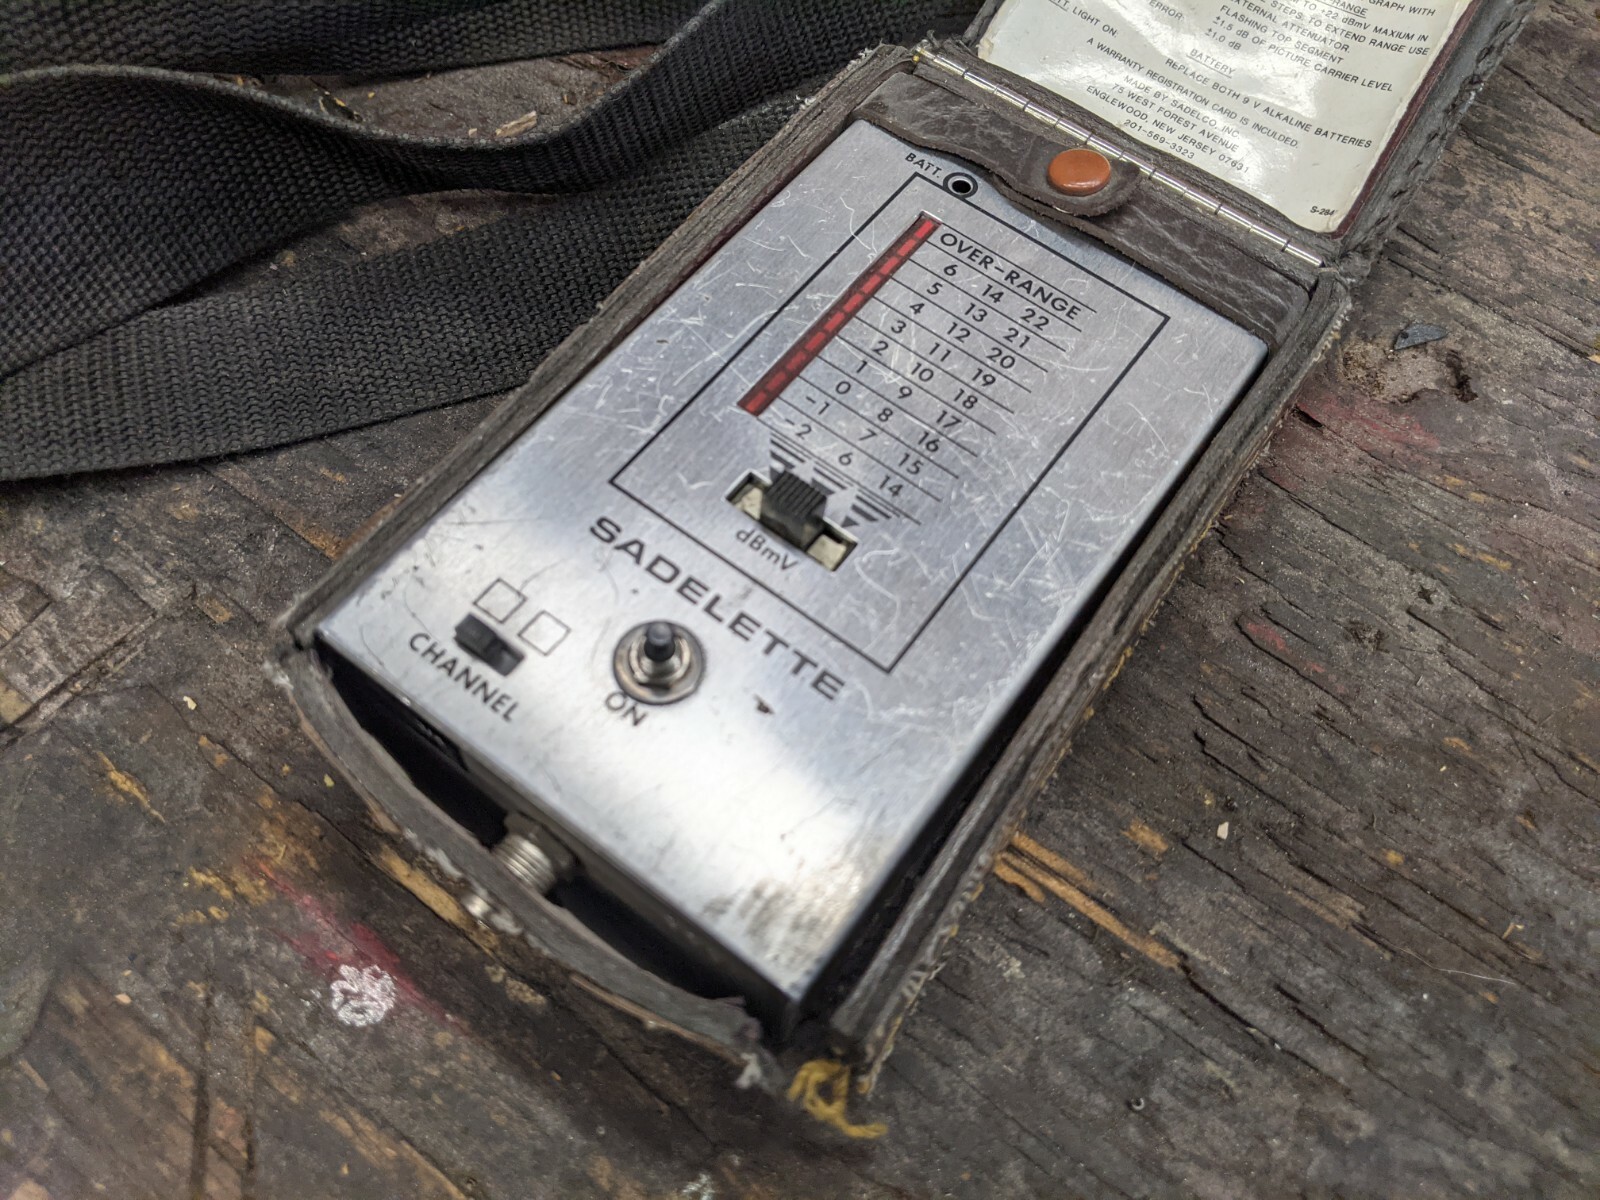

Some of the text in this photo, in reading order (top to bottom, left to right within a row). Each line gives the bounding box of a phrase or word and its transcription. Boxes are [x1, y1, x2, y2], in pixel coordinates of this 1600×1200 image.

[1072, 6, 1100, 26] LIGHT
[1102, 24, 1118, 38] ON:
[1205, 28, 1242, 50] ±1.0 dB
[1220, 4, 1344, 64] FLASHING TOP SEGMENT
[1282, 20, 1350, 54] ATTENUATOR.
[1304, 0, 1316, 10] TO
[1321, 9, 1339, 20] +22
[1342, 16, 1370, 30] dBmV
[1373, 26, 1415, 40] MAXIUM
[1308, 17, 1322, 28] TO
[1325, 24, 1366, 43] EXTEND
[1368, 38, 1406, 52] RANGE
[1408, 46, 1430, 56] USE
[1408, 6, 1437, 16] WITH
[1190, 48, 1236, 76] BATTERY
[1212, 16, 1393, 92] ±1.5 dB OF PICTURE CARRIER LEVEL
[1086, 37, 1299, 148] A WARRANTY REGISTRATION CARD IS INCULDED.
[1112, 83, 1240, 152] 75 WEST FOREST AVENUE
[1124, 74, 1152, 94] MADE
[1153, 90, 1169, 101] BY
[1221, 125, 1240, 139] INC.
[1165, 58, 1210, 86] REPLACE
[1212, 82, 1240, 100] BOTH
[1262, 106, 1312, 132] ALKALINE
[1314, 128, 1372, 148] BATTERIES
[905, 152, 942, 178] BATT.
[1124, 119, 1195, 160] 201-569-3323
[1152, 119, 1176, 134] NEW
[1178, 134, 1217, 156] JERSEY
[1218, 153, 1250, 174] 07631
[940, 232, 1082, 320] OVER-RANGE
[944, 264, 1050, 330] 6 14 22
[909, 302, 1016, 370] 4 12 20
[926, 282, 1030, 349] 5 13 21
[872, 341, 978, 410] 2 10 18
[890, 320, 996, 388] 3 11 19
[835, 380, 940, 453] 0 8 16
[856, 360, 962, 431] 1 9 17
[785, 418, 904, 497] -2 6 14
[806, 395, 924, 476] -1 7 15
[736, 527, 800, 572] dBmV
[590, 516, 845, 700] SADELETTE
[409, 632, 520, 723] CHANNEL
[605, 691, 648, 726] ON
